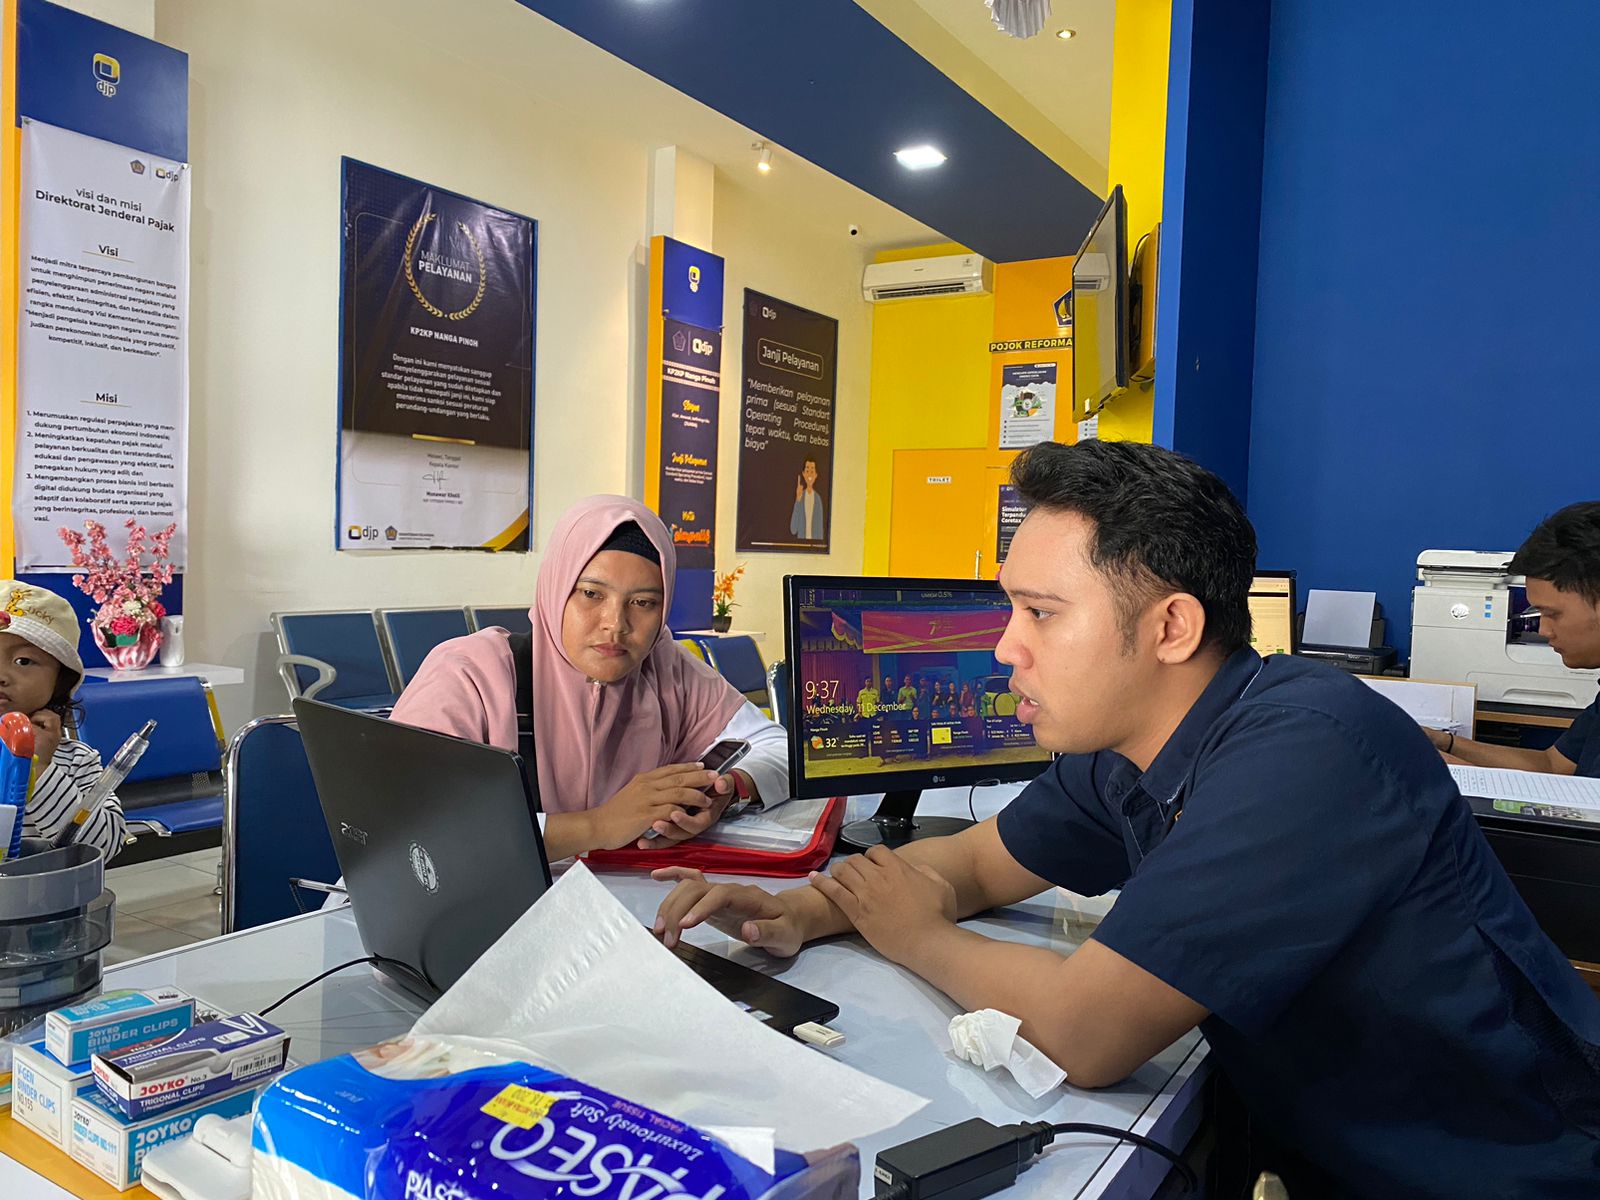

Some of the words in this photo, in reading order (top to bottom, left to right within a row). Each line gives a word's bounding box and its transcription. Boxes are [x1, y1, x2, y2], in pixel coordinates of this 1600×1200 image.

[97, 81, 117, 97] djp
[166, 170, 179, 182] djp
[76, 189, 93, 200] visi
[97, 193, 117, 206] dan
[120, 200, 142, 212] misi
[35, 190, 95, 212] Direktorat
[98, 205, 144, 224] Jenderal
[148, 217, 174, 232] Pajak
[99, 245, 118, 257] Visi
[31, 255, 57, 265] Menjadi
[421, 251, 470, 270] MAKLUMAT
[31, 267, 51, 275] untuk
[418, 260, 472, 283] PELAYANAN
[30, 300, 53, 309] rangka
[55, 304, 94, 317] mendukung
[119, 303, 129, 311] dan
[133, 338, 147, 347] yang
[410, 327, 433, 338] KP2KP
[434, 332, 457, 343] NANGA
[459, 336, 478, 347] PINOH
[991, 341, 1022, 352] POJOK
[762, 346, 781, 364] Janji
[782, 351, 819, 372] Pelayanan
[96, 393, 117, 403] Misi
[797, 391, 830, 406] pelayanan
[746, 394, 768, 407] prima
[773, 399, 797, 413] (sesuai
[802, 405, 830, 420] Standart
[33, 411, 78, 420] Merumuskan
[108, 419, 142, 427] perpajakan
[746, 408, 782, 427] Operating
[35, 422, 62, 431] dukung
[63, 425, 109, 434] pertumbuhan
[745, 423, 765, 438] tepat
[793, 432, 806, 443] dan
[810, 434, 829, 447] bebas
[34, 443, 70, 451] pelayanan
[35, 432, 84, 442] Meningkatkan
[122, 440, 138, 448] pajak
[34, 474, 94, 484] Mengembangkan
[58, 486, 90, 495] didukung
[34, 495, 59, 503] adaptif
[363, 526, 379, 540] djp
[805, 680, 839, 700] 9:37
[806, 704, 855, 716] Wednesday,
[866, 701, 907, 714] December
[825, 738, 836, 748] 32
[88, 1024, 120, 1038] JOYKO
[88, 1029, 138, 1048] BINDER
[143, 1018, 178, 1033] CLIPS
[17, 1064, 34, 1084] V-GEN
[17, 1077, 37, 1102] BINDER
[39, 1094, 55, 1114] CLIPS
[139, 1079, 185, 1096] JOYKO
[139, 1091, 180, 1108] TRIGONAL
[182, 1084, 206, 1096] CLIPS
[571, 1102, 605, 1123] Soft
[612, 1100, 647, 1120] TISSUE
[74, 1111, 89, 1126] JOYKO
[650, 1115, 685, 1134] FACIAL
[135, 1118, 192, 1147] JOYKO
[604, 1112, 704, 1161] Luxuriously
